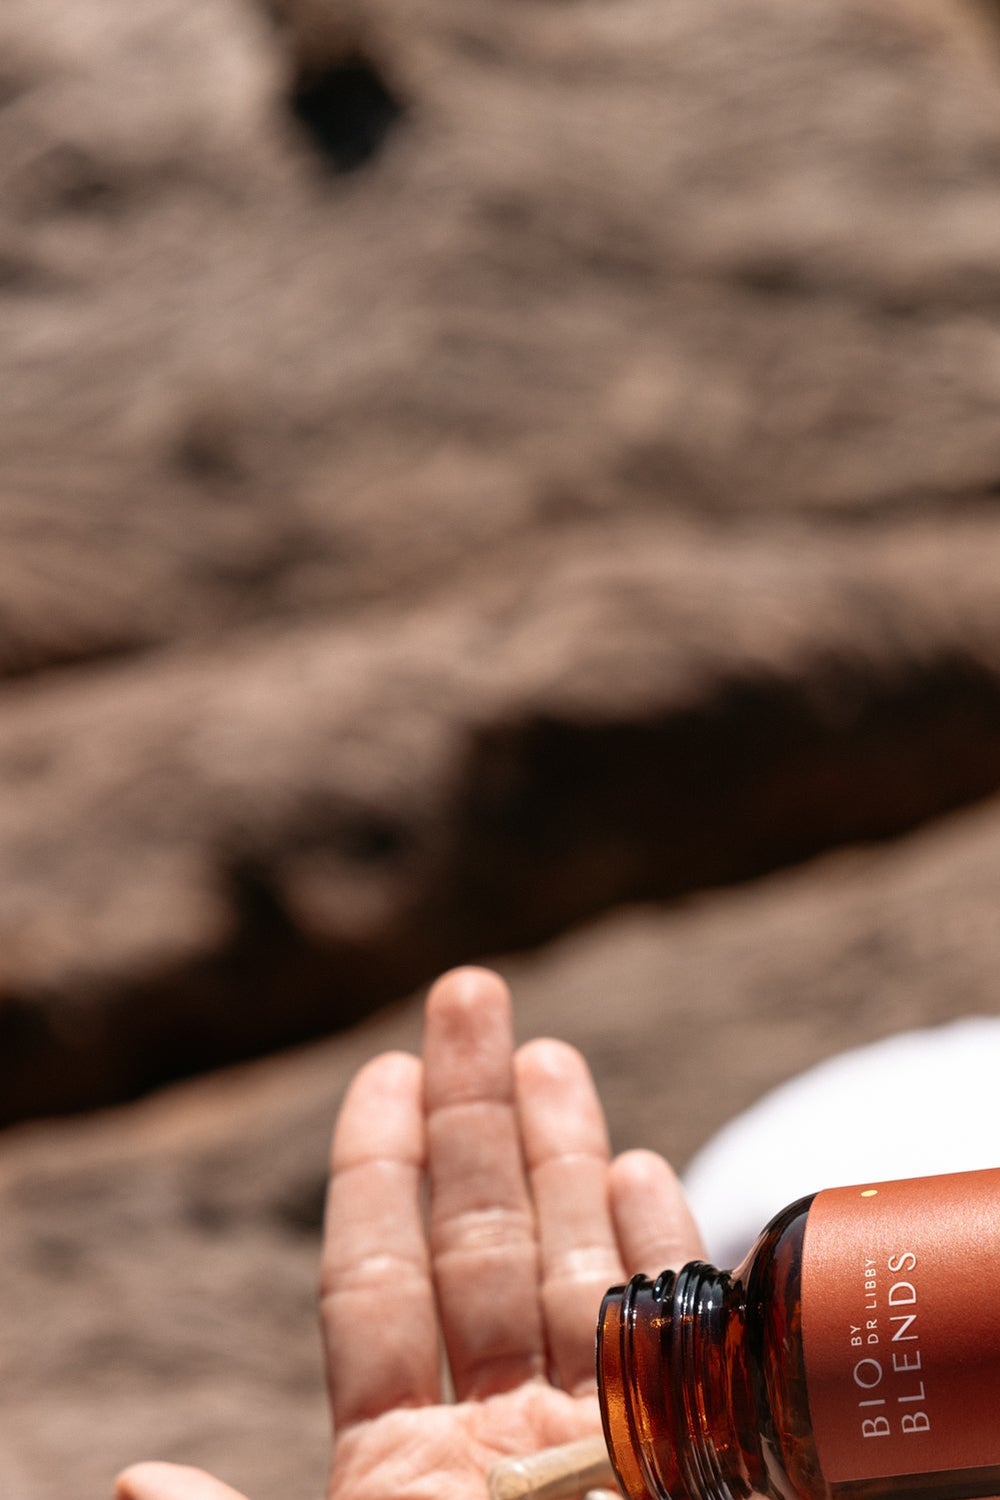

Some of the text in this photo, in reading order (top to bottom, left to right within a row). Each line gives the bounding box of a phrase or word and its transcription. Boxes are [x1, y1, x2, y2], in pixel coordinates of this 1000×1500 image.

[851, 1325, 862, 1346] BY
[865, 1259, 879, 1345] DR LIBBY
[887, 1252, 930, 1433] BLENDS
[853, 1358, 890, 1438] BIO
